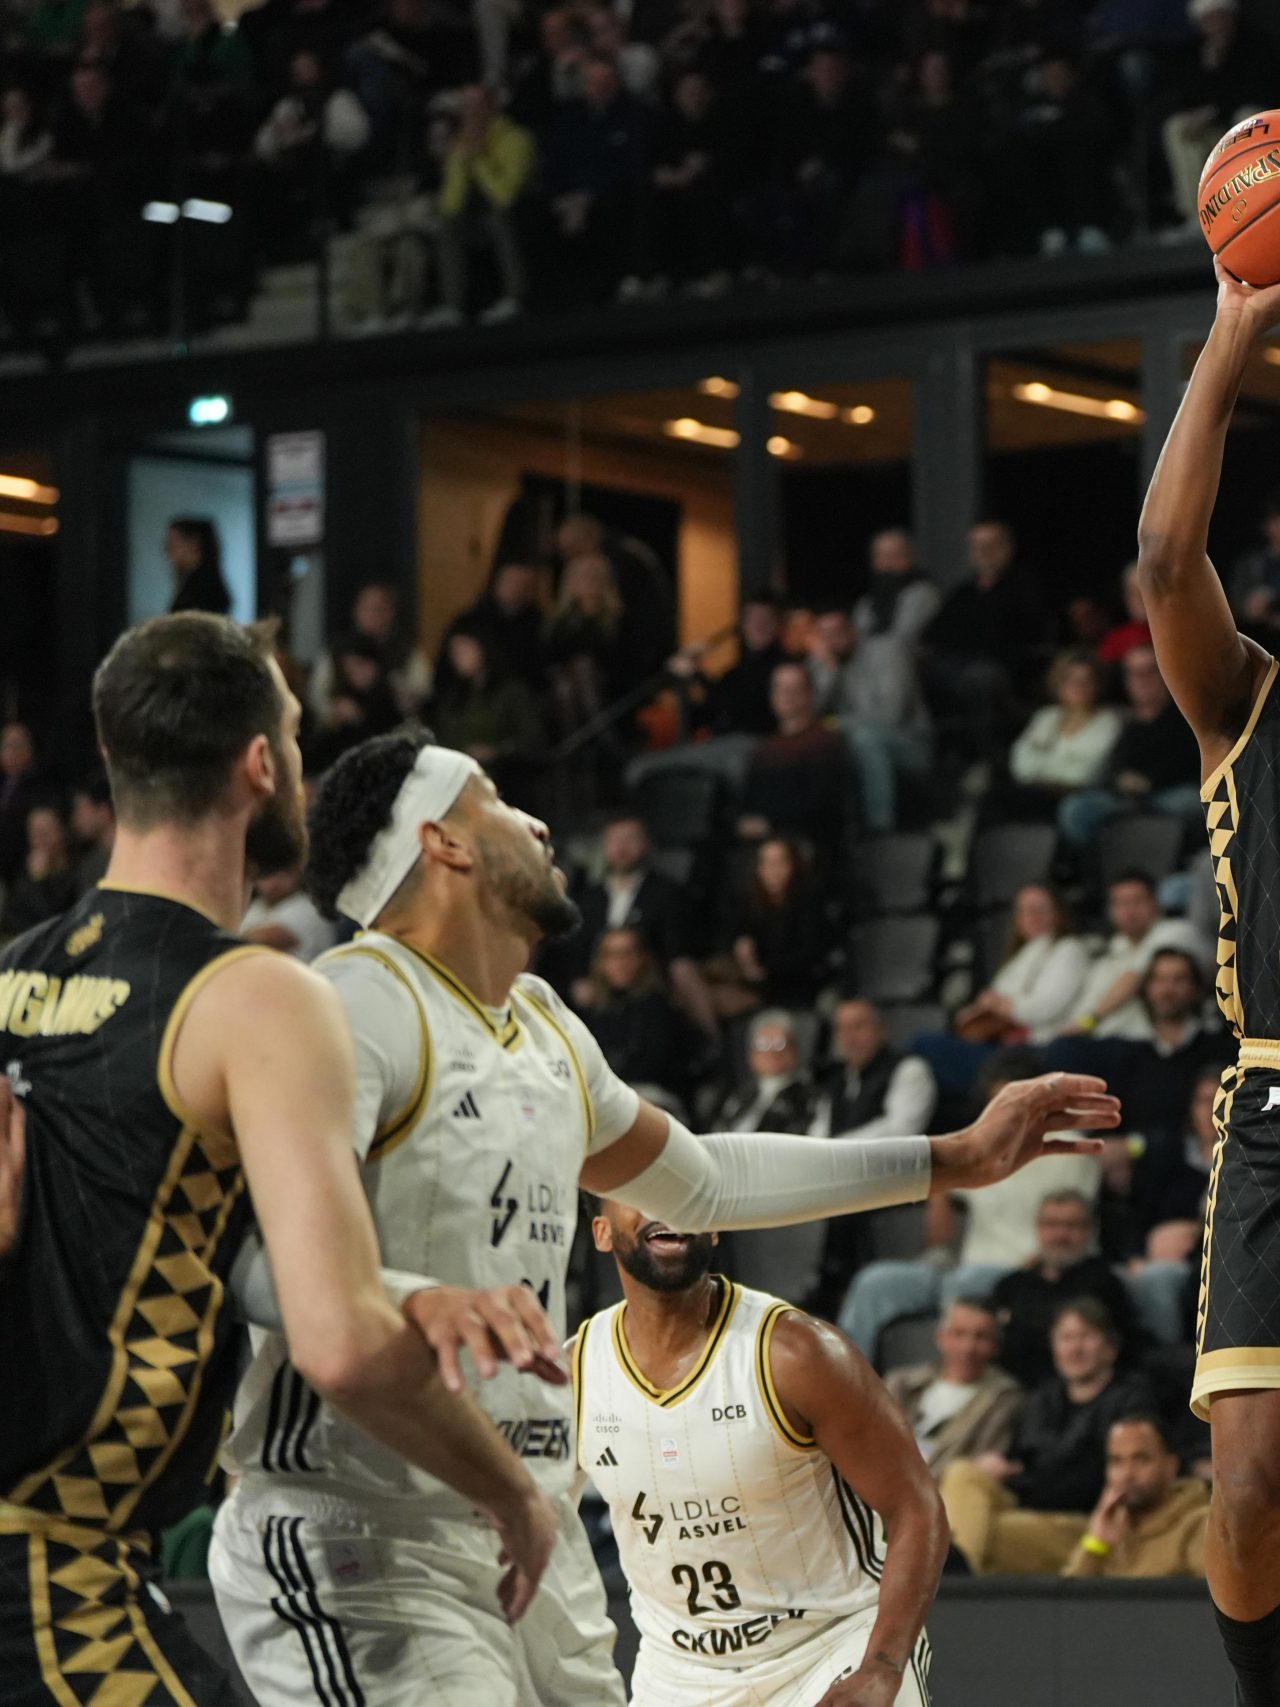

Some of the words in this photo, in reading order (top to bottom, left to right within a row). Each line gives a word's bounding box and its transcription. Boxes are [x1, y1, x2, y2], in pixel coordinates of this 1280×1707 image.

[528, 1184, 566, 1216] LDL
[529, 1222, 565, 1247] ASVE
[712, 1404, 747, 1422] DCB
[670, 1496, 741, 1521] LDLC
[679, 1516, 747, 1540] ASVEL
[671, 1561, 742, 1617] 23
